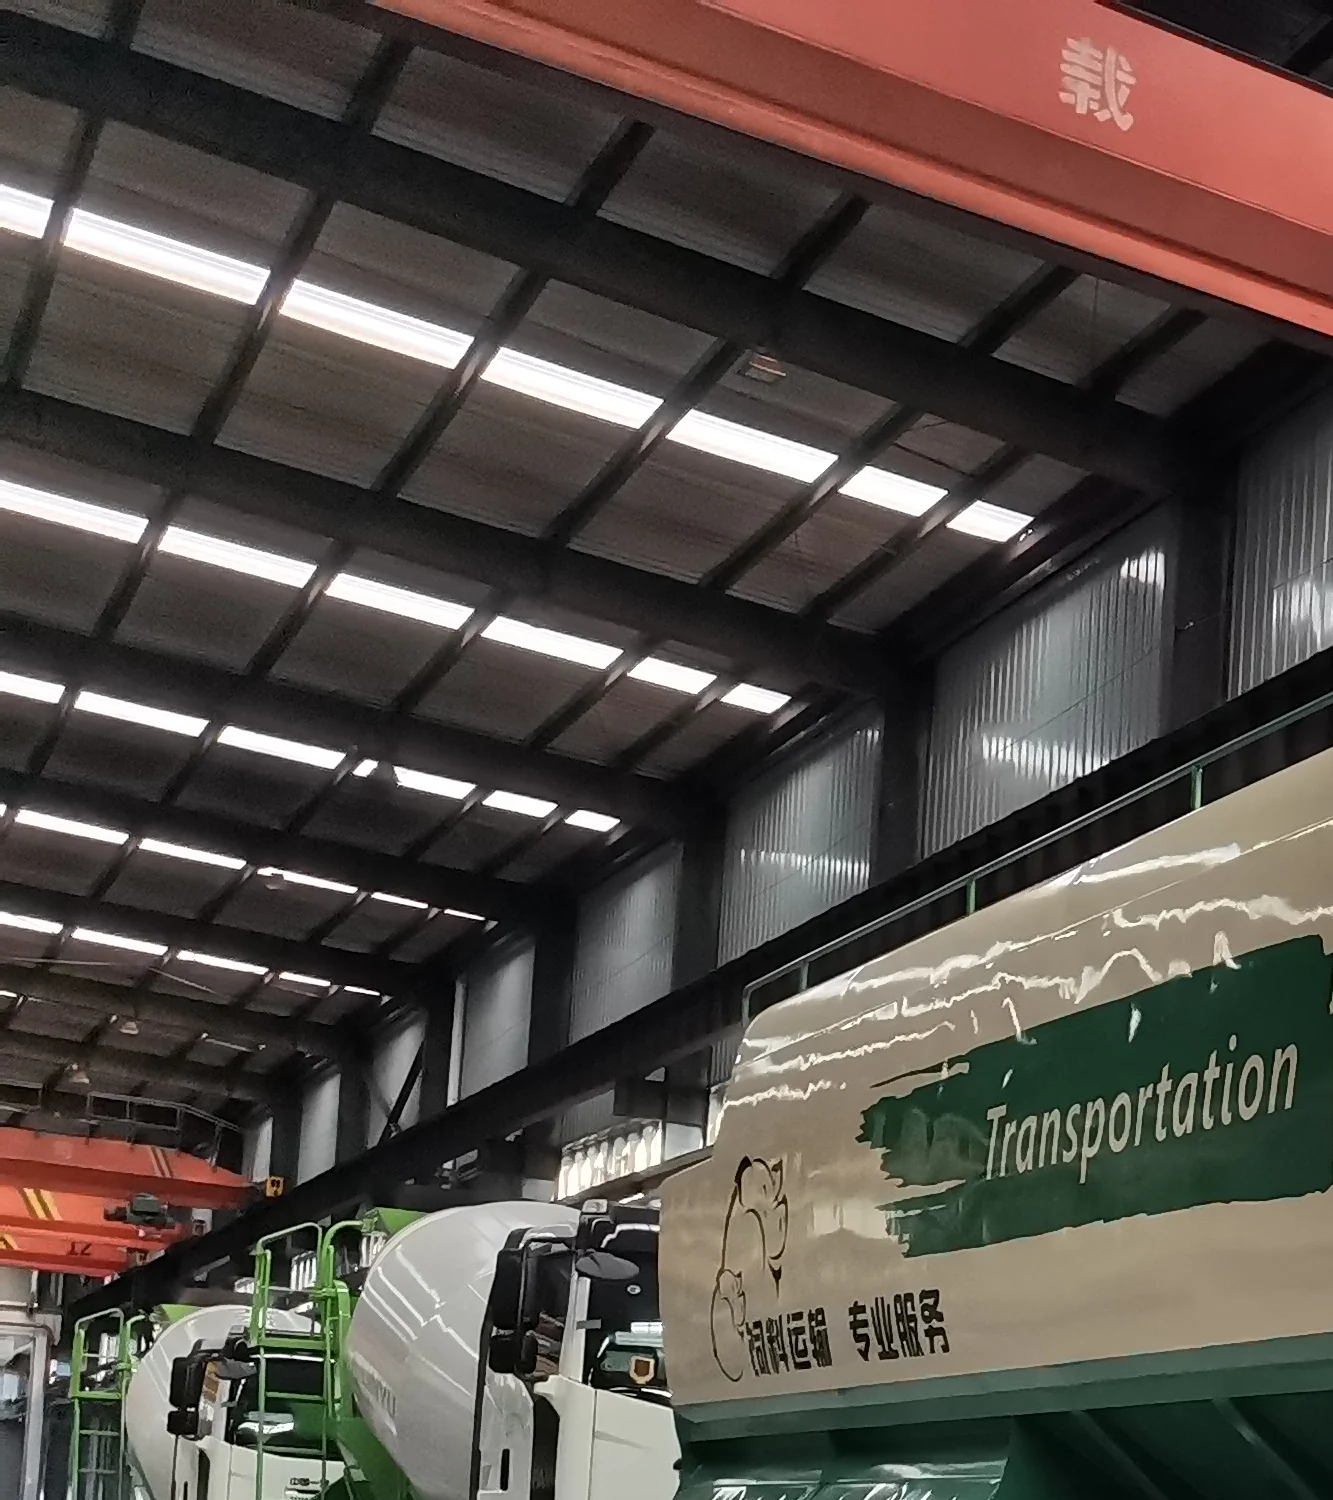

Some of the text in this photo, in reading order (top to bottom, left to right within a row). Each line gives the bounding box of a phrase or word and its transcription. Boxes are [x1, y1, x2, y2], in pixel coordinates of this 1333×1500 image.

[984, 1040, 1298, 1183] Transportation
[745, 1288, 950, 1378] 饲料运输 专业服务
